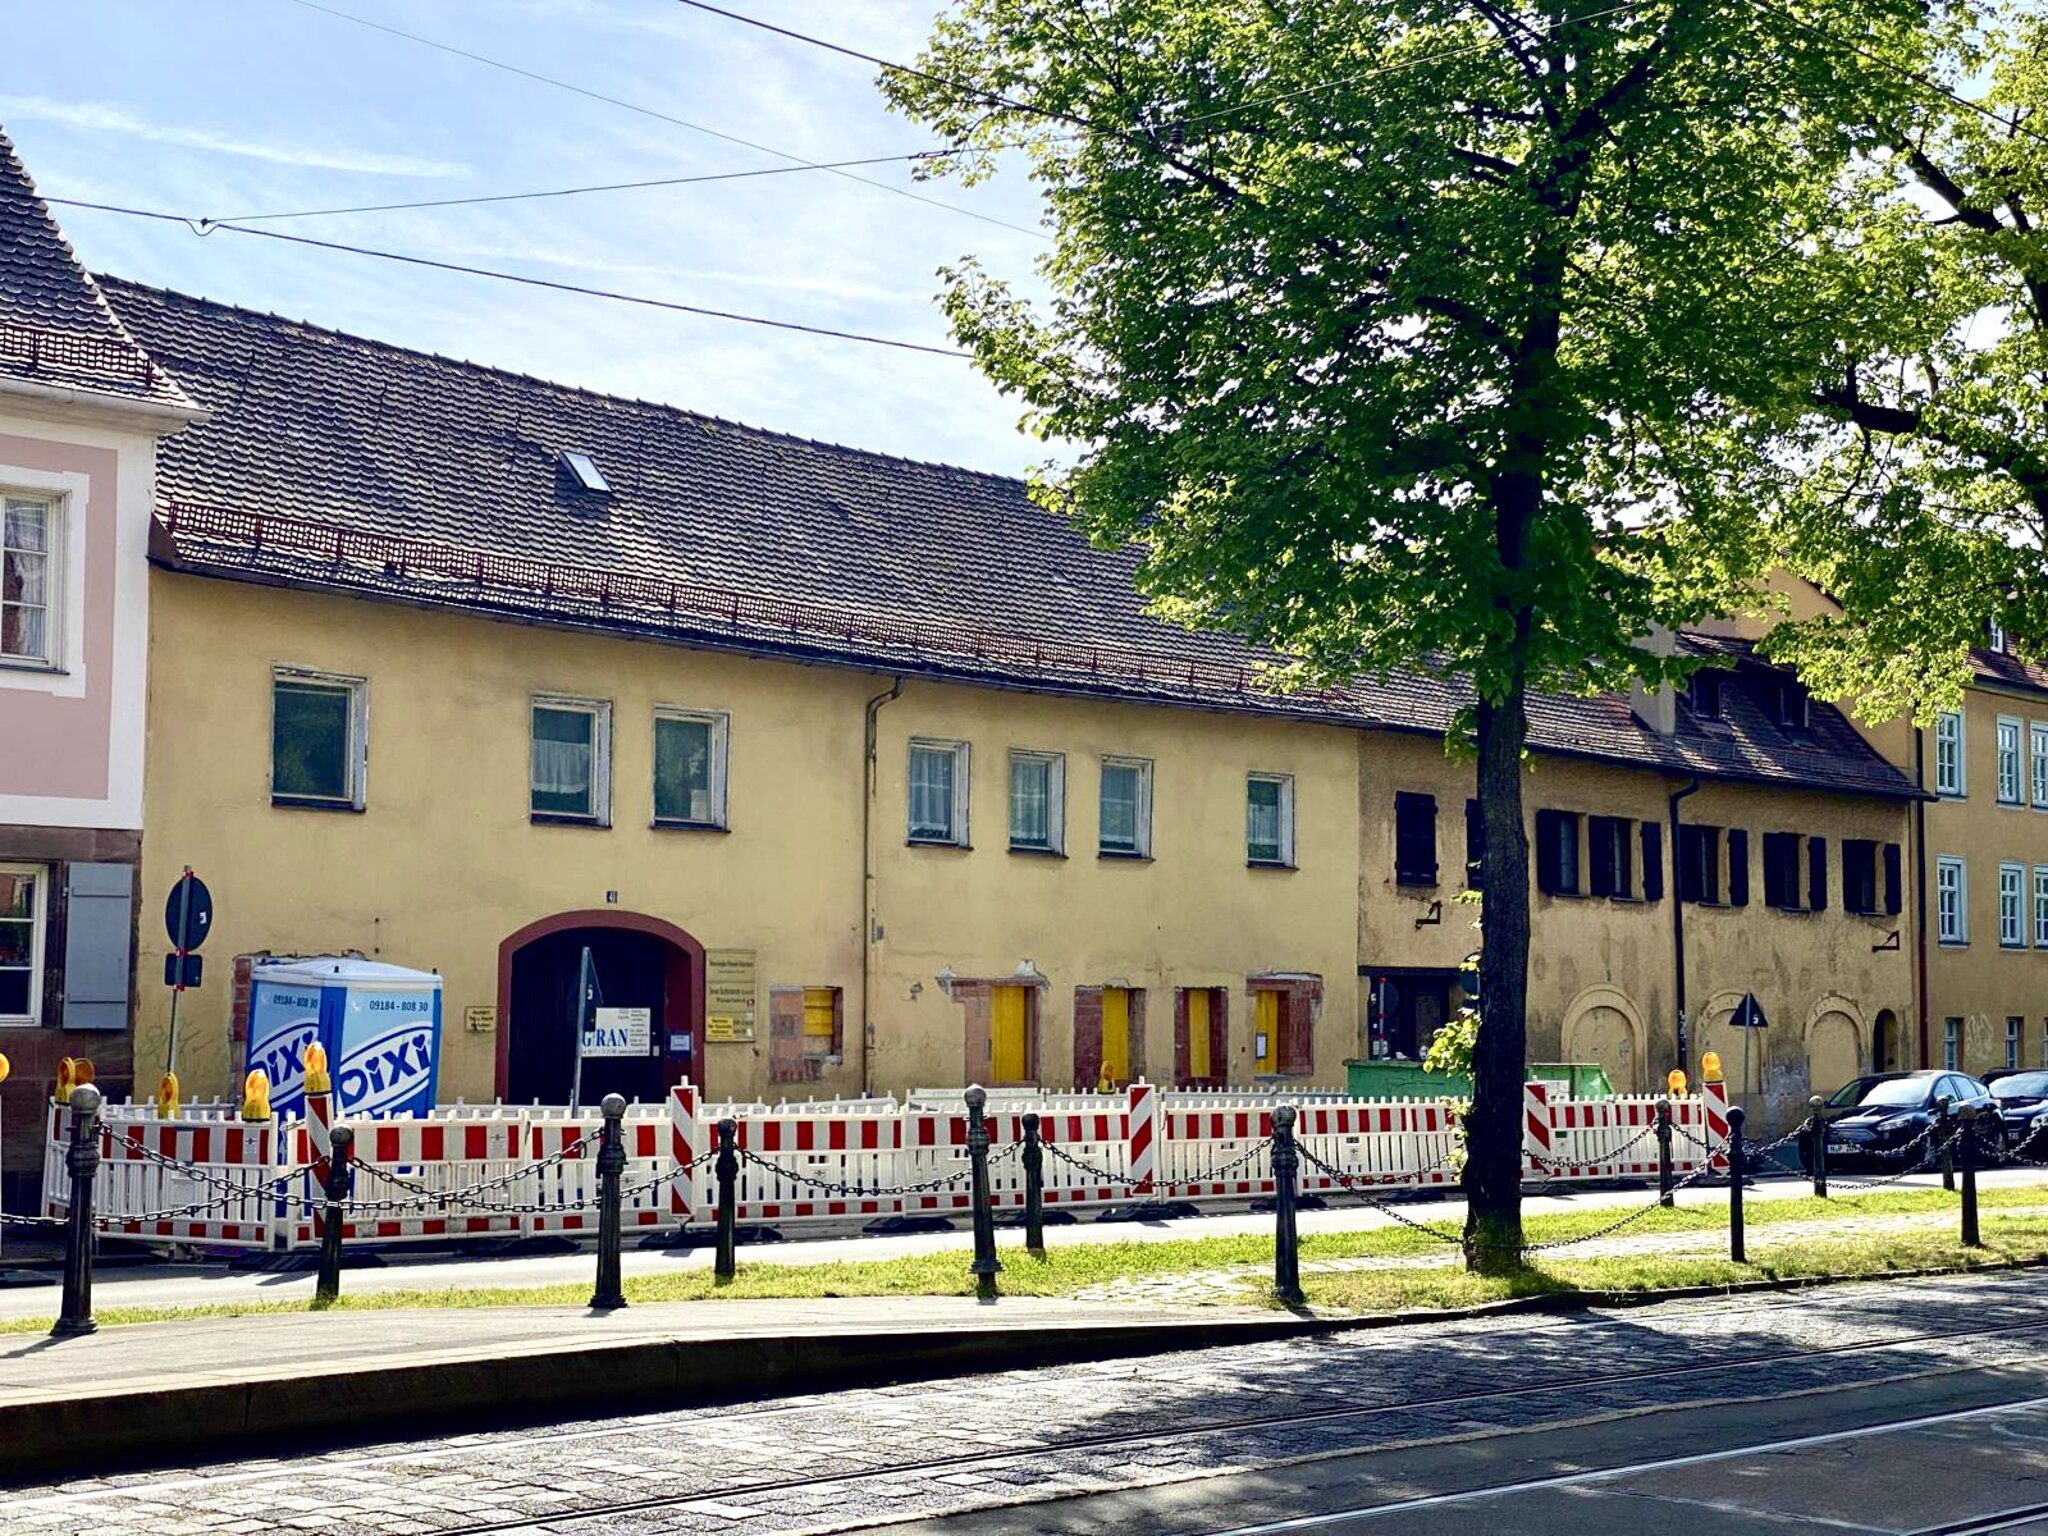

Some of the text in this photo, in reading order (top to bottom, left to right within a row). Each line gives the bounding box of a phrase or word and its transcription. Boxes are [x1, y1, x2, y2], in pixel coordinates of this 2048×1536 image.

[370, 1000, 395, 1010] 09184
[401, 1001, 417, 1012] 808
[418, 1001, 429, 1012] 30
